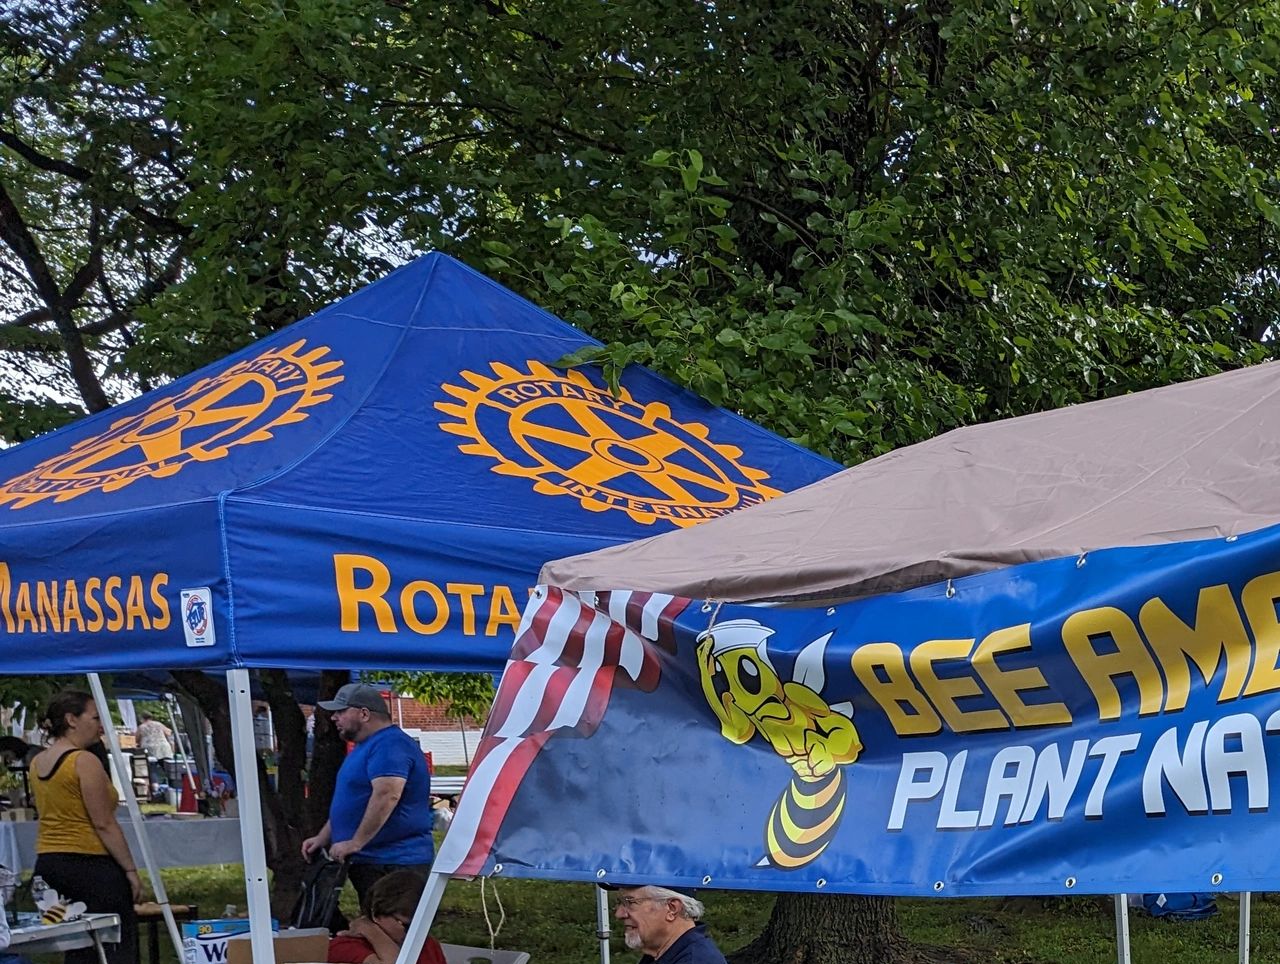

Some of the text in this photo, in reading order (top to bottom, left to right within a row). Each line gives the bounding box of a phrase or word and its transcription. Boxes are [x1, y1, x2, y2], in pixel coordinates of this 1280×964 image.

[498, 382, 625, 411] ROTARY
[333, 553, 537, 637] ROTA
[850, 621, 1073, 738] BEE
[887, 732, 1141, 832] PLANT
